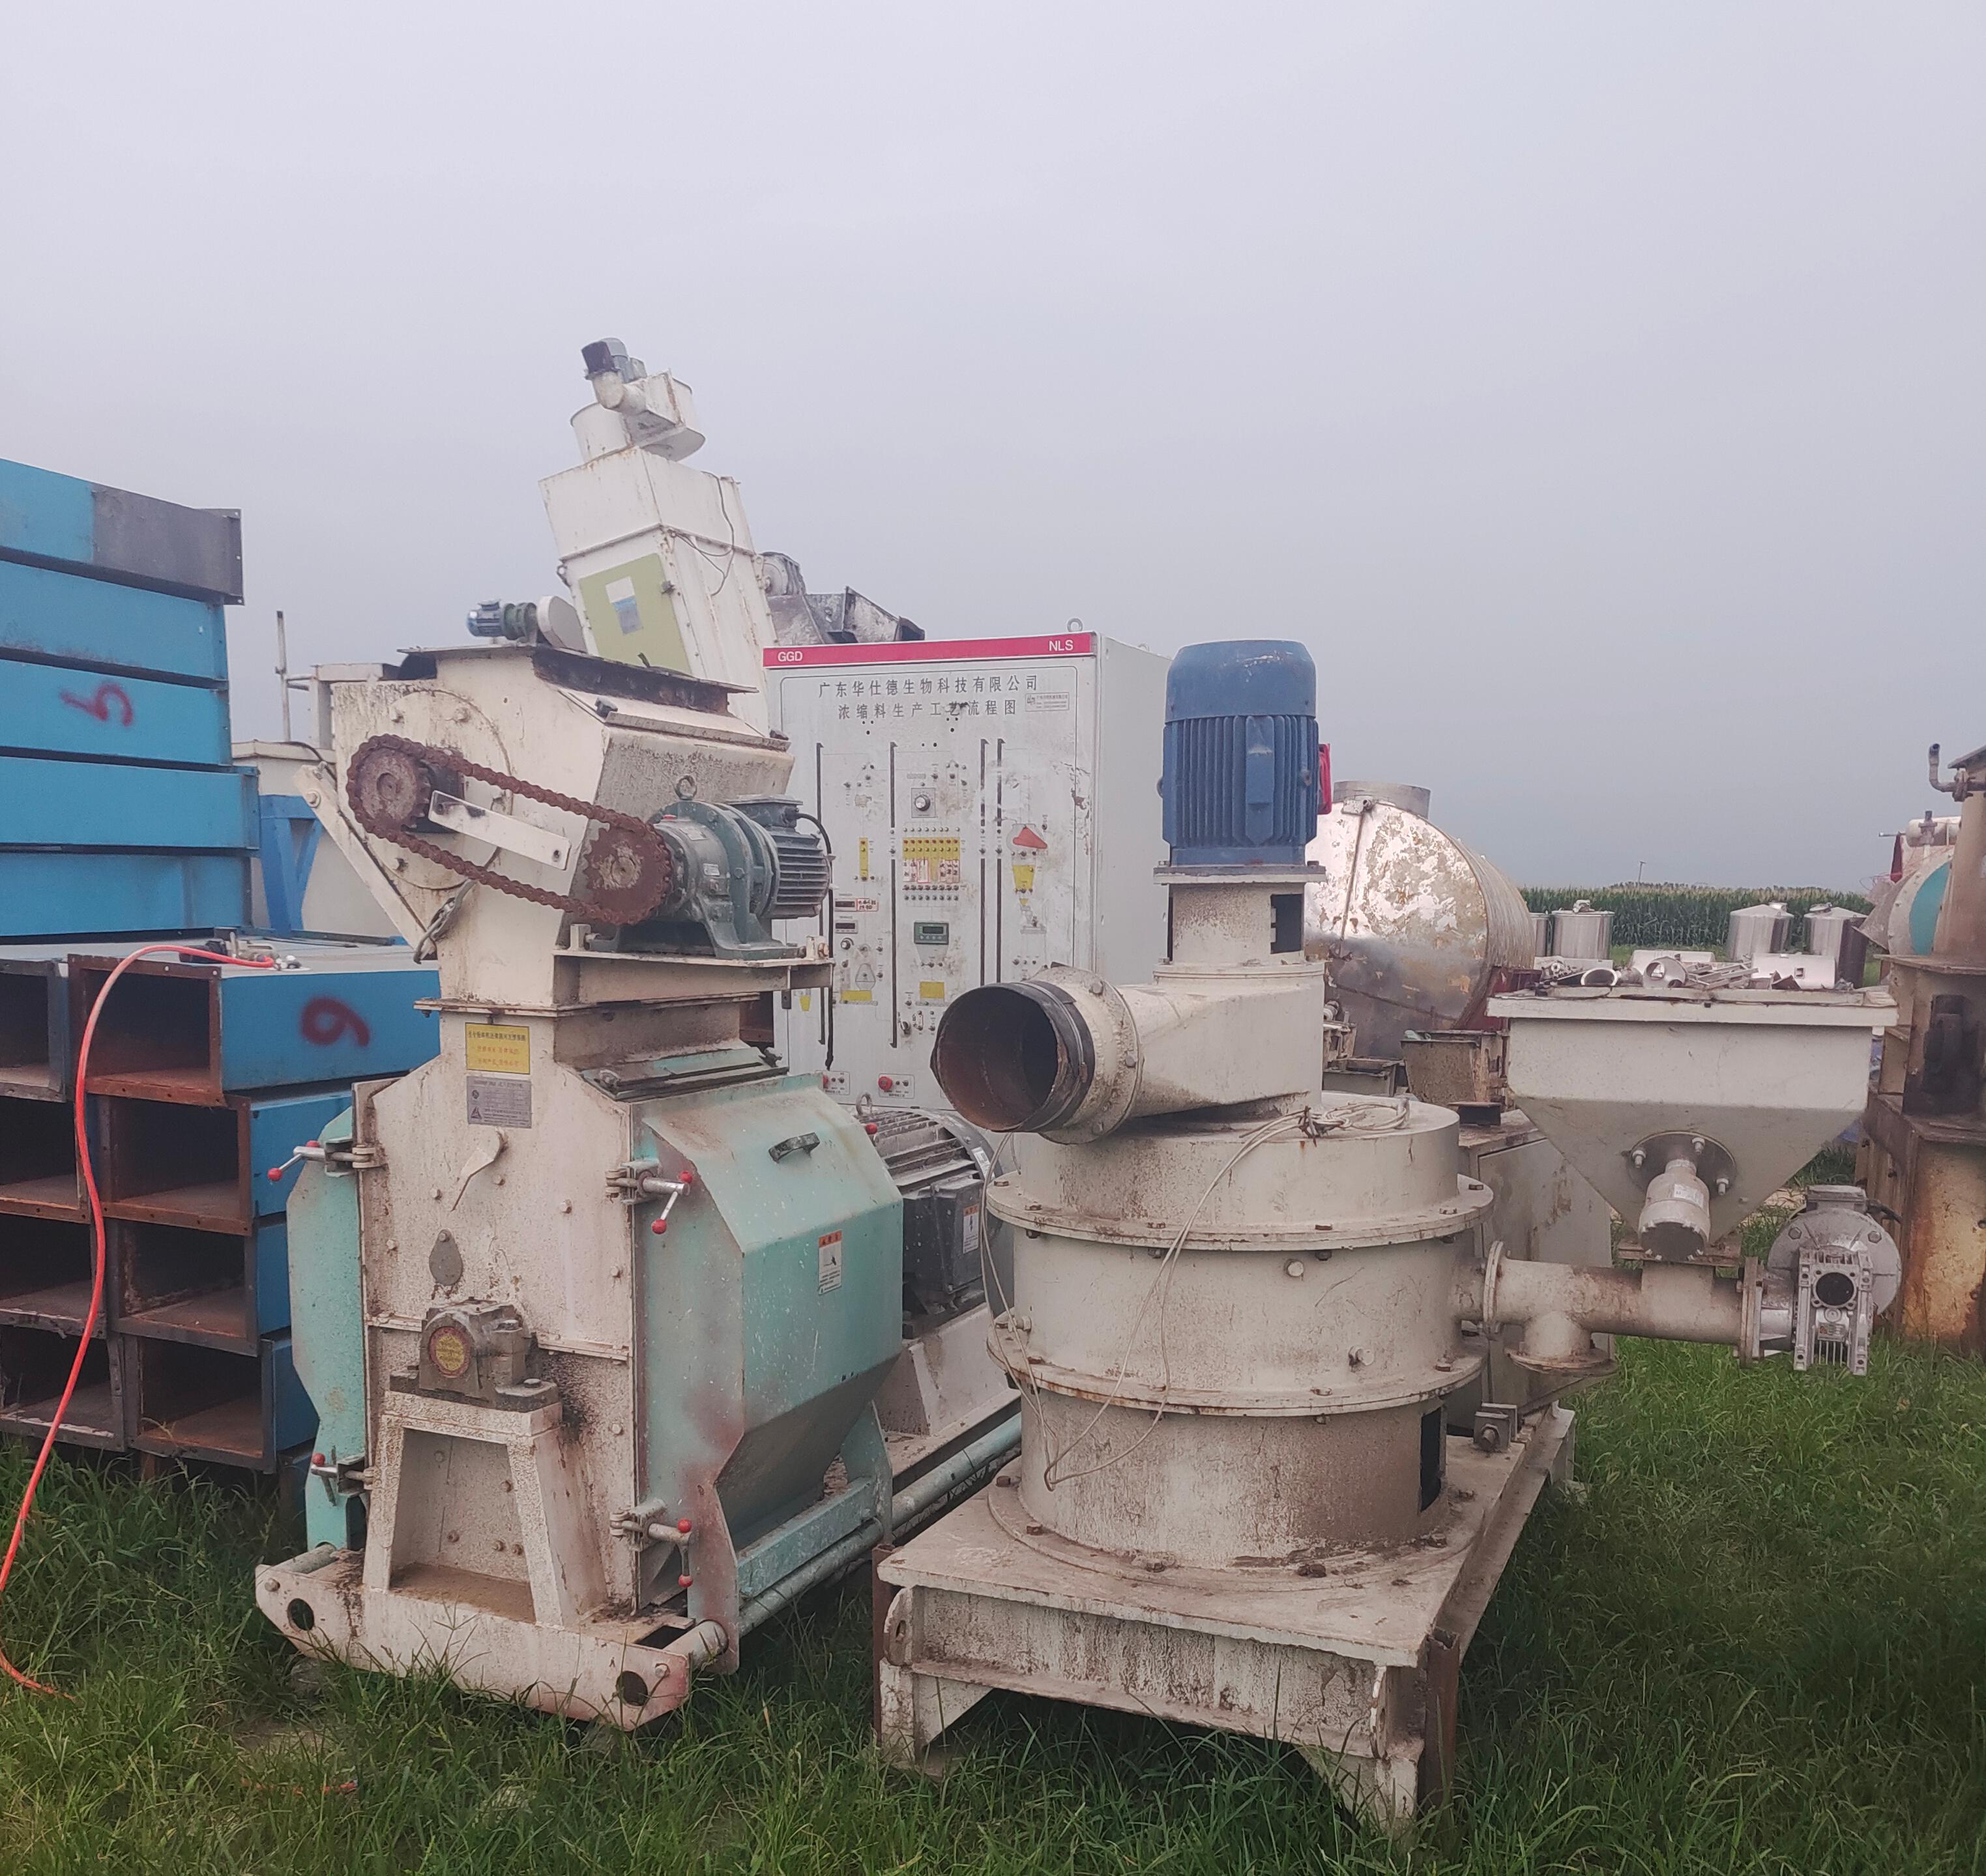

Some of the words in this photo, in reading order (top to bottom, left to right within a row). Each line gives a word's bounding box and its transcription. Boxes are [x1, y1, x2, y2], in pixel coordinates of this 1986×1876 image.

[1049, 639, 1073, 651] NLS
[778, 651, 803, 662] GGD
[819, 675, 1037, 698] 广东华仕德生物科技有限公司
[838, 700, 1016, 719] 浓缩料生产工艺流程图
